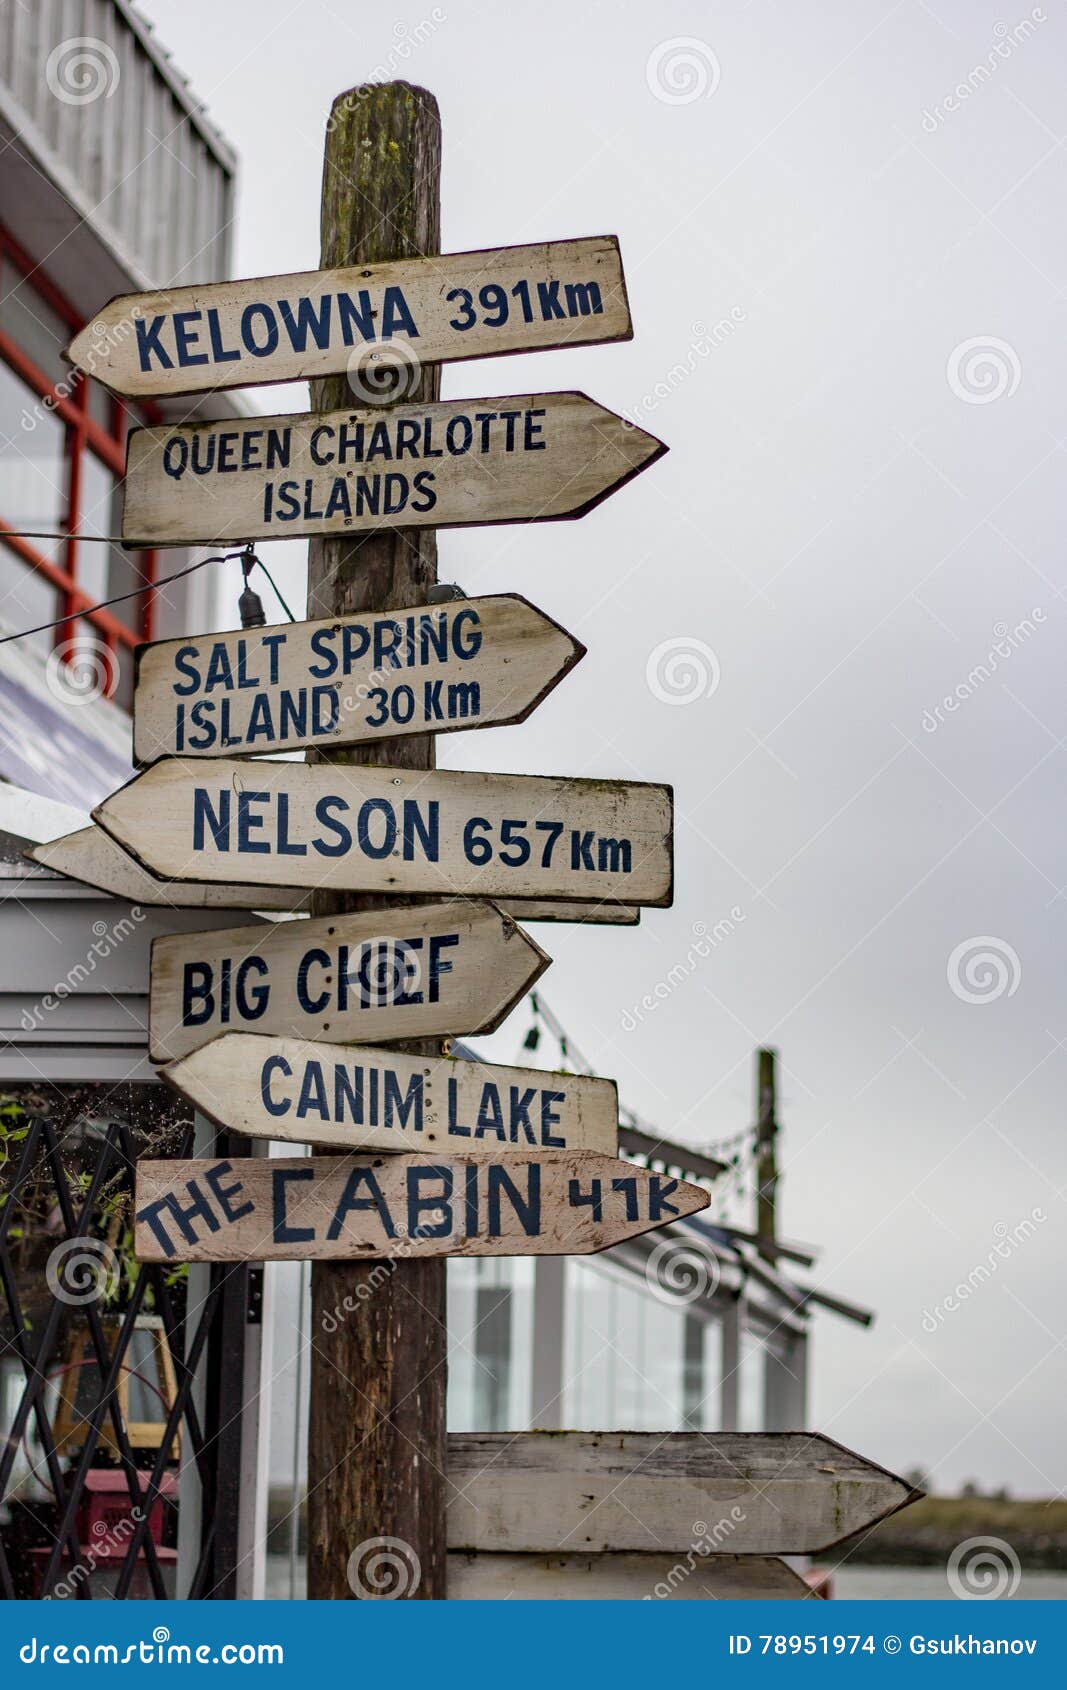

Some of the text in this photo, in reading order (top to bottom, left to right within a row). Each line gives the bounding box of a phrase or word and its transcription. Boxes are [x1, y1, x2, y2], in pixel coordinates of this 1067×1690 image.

[135, 285, 420, 372] KELOWNA
[162, 409, 547, 478] QUEEN CHARLOTTE
[263, 471, 438, 523] ISLANDS
[172, 608, 483, 697] SALT SPRING
[175, 684, 341, 752] ISLAND
[193, 787, 440, 863] NELSON
[182, 933, 461, 1027] BIG CHIEF
[261, 1055, 567, 1148] CANIM LAKE
[136, 1161, 255, 1258] THE
[272, 1162, 542, 1244] CABIN
